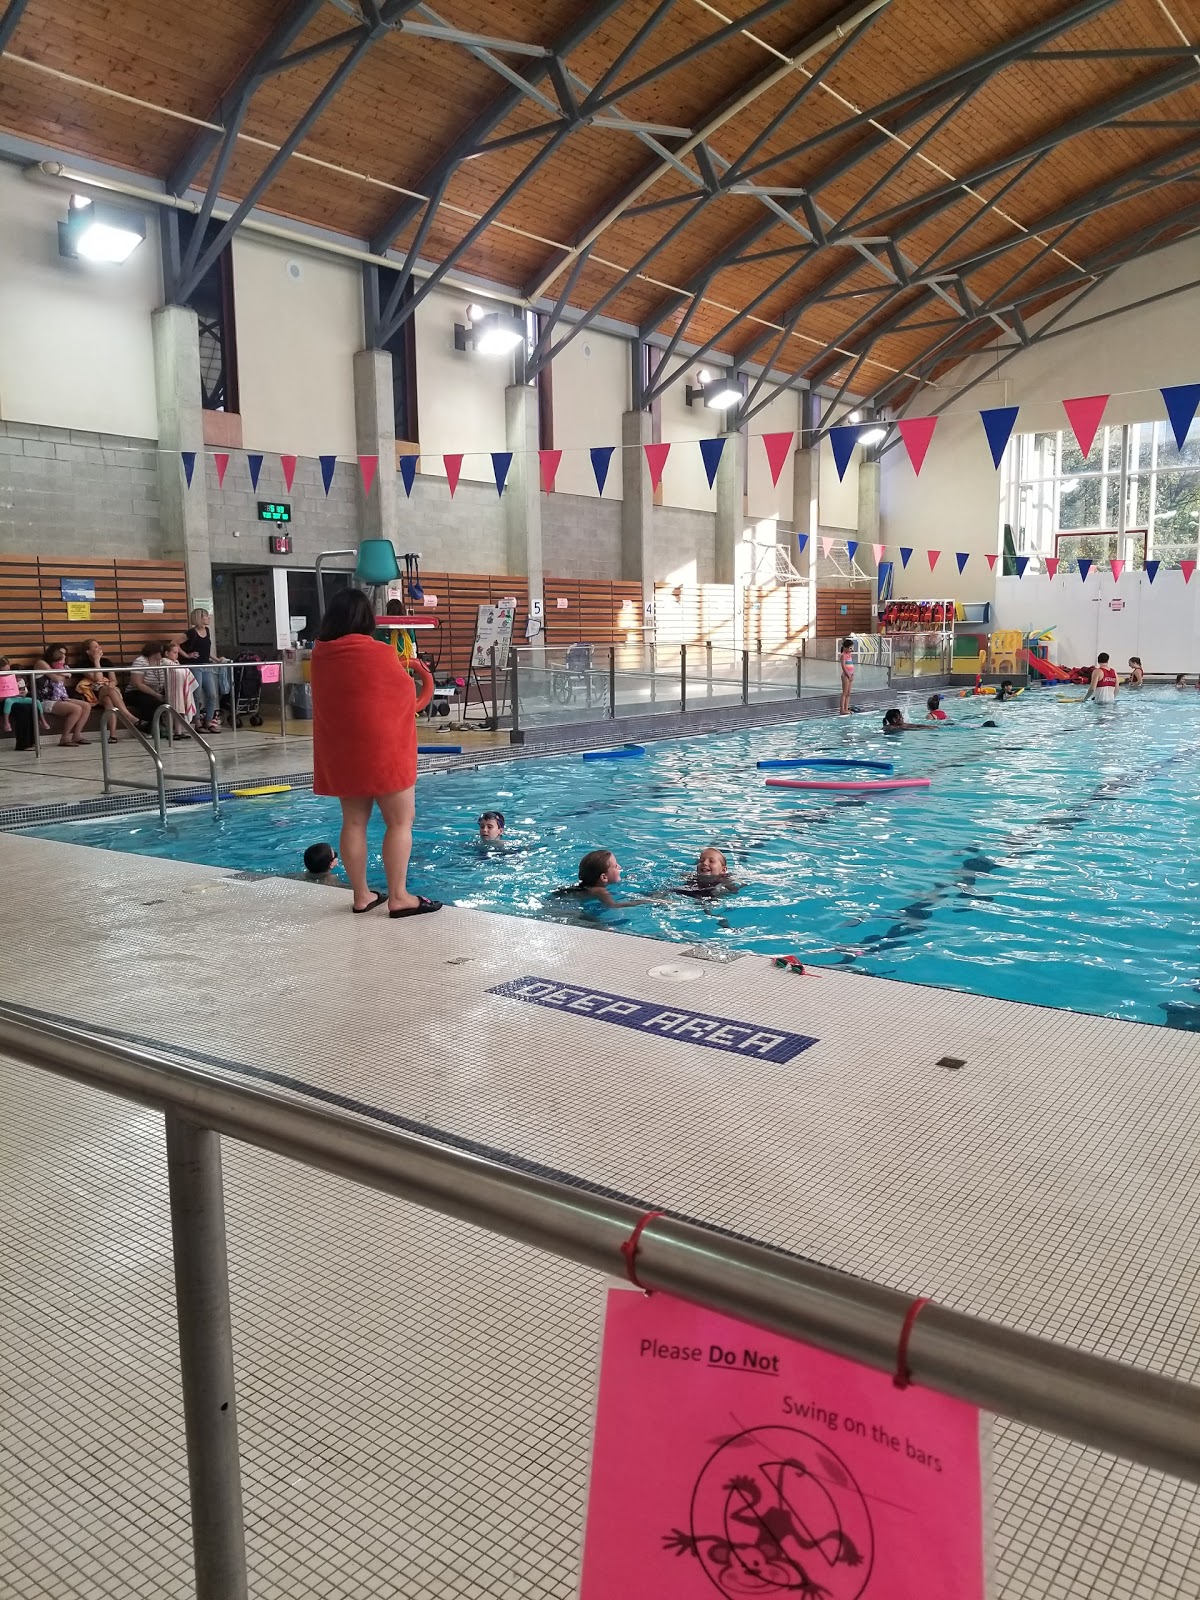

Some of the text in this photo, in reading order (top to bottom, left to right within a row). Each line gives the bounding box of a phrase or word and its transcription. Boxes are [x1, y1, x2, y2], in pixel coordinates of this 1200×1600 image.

[534, 601, 541, 615] 5
[646, 603, 652, 614] 4
[514, 982, 787, 1053] DEEP AREA
[640, 1338, 780, 1374] Please Do Not
[782, 1396, 943, 1473] Swing on the bars
